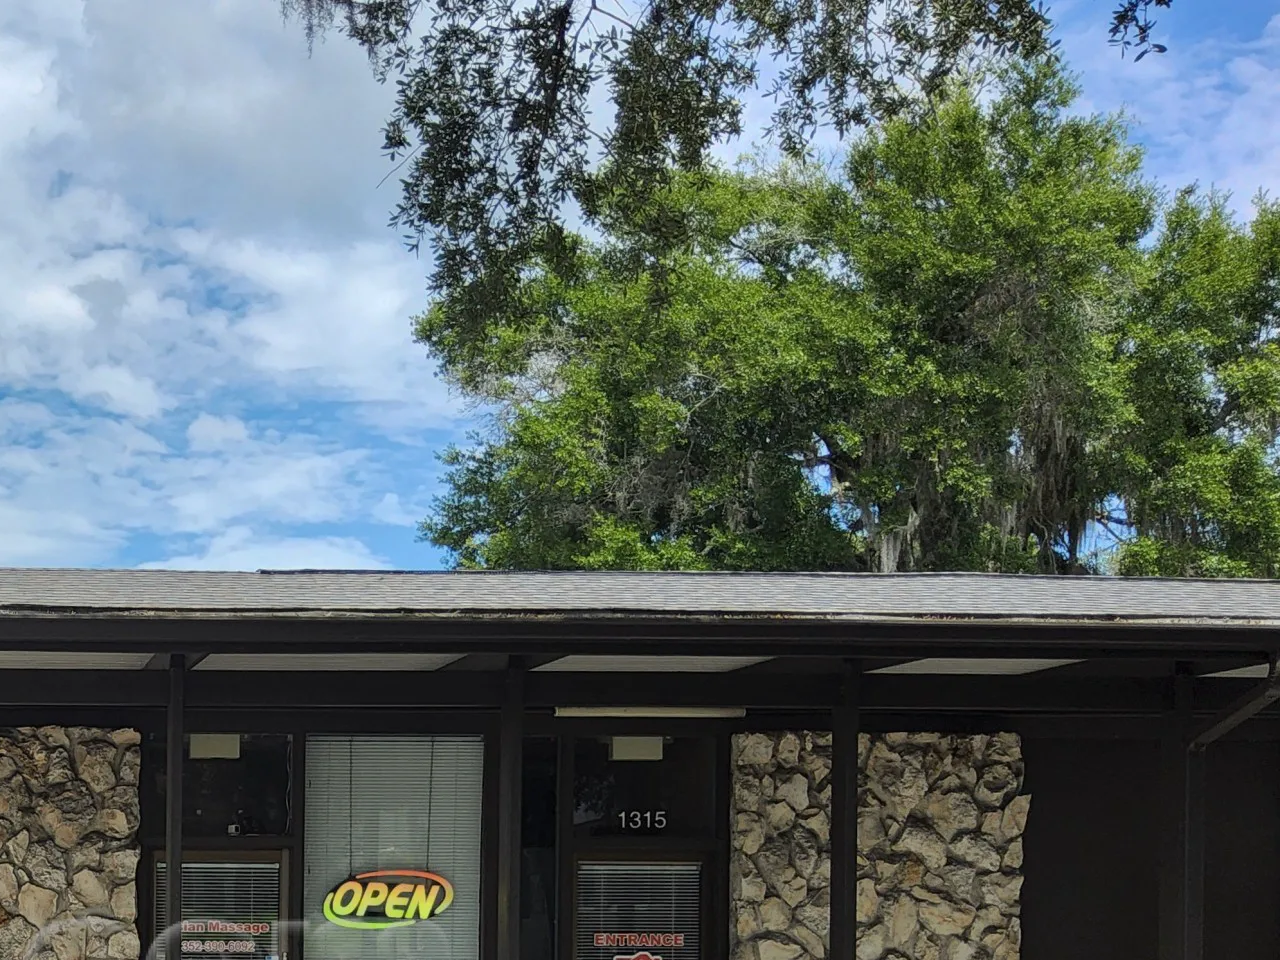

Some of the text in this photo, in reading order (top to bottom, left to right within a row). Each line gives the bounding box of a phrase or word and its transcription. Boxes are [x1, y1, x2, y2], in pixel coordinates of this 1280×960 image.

[617, 811, 668, 829] 1315
[332, 880, 441, 920] OPEN
[208, 920, 270, 936] Massage
[181, 940, 256, 953] 352-390-6092
[593, 933, 685, 948] ENTRANCE
